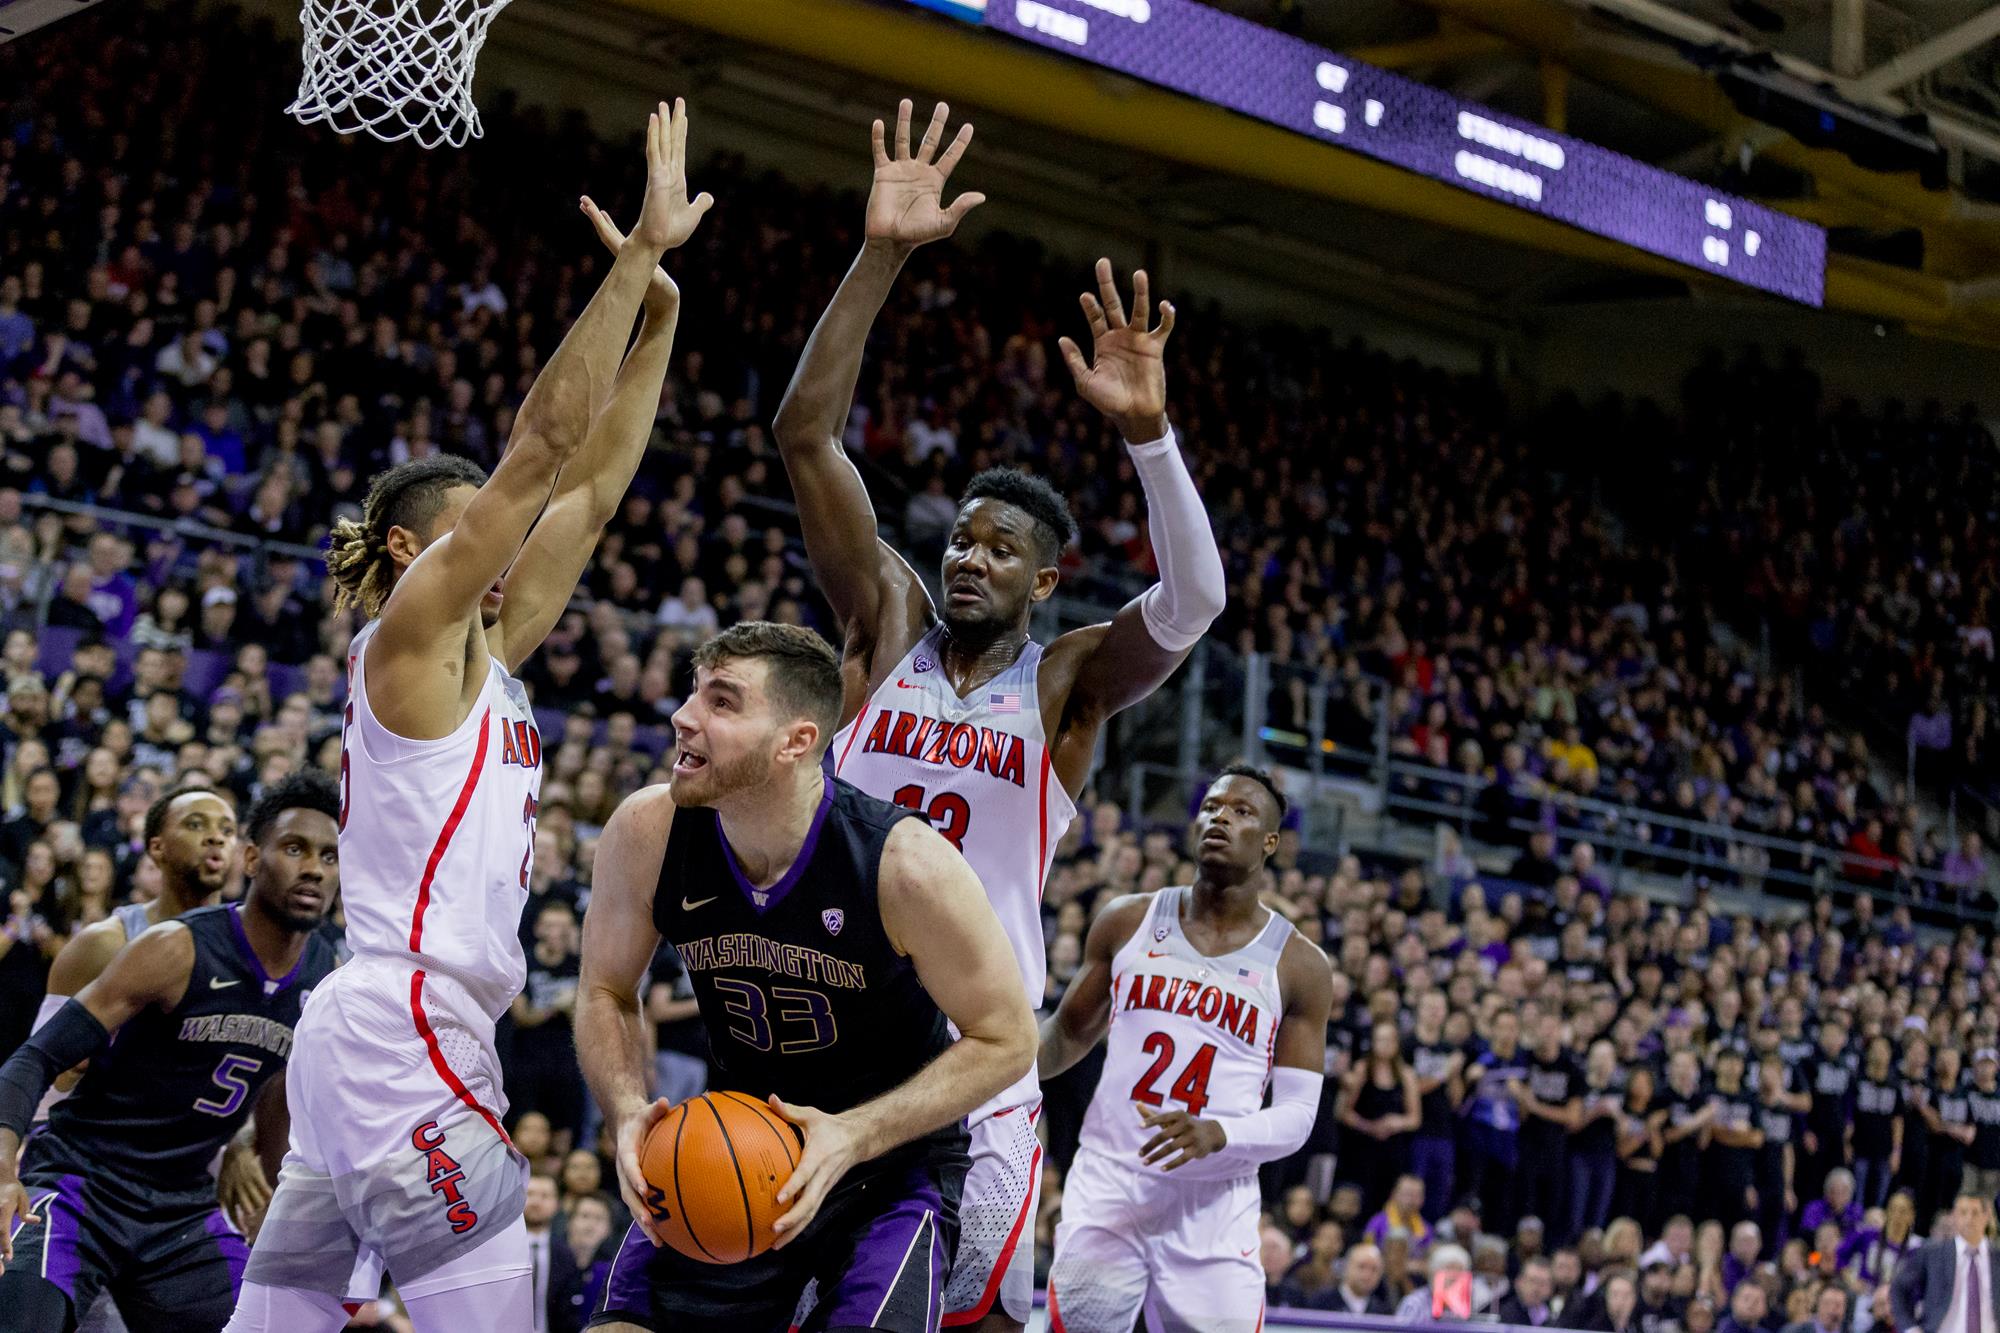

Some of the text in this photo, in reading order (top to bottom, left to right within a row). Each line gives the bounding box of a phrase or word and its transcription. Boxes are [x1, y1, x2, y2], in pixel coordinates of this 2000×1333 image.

[862, 709, 1026, 789] ARIZONA
[676, 933, 867, 990] WASHINGTON
[178, 1014, 295, 1062] WASHINGT
[714, 977, 838, 1054] 33
[1124, 974, 1259, 1046] ARIZONA
[193, 1053, 263, 1118] 5
[1130, 1031, 1218, 1117] 24
[411, 1120, 478, 1234] CATS
